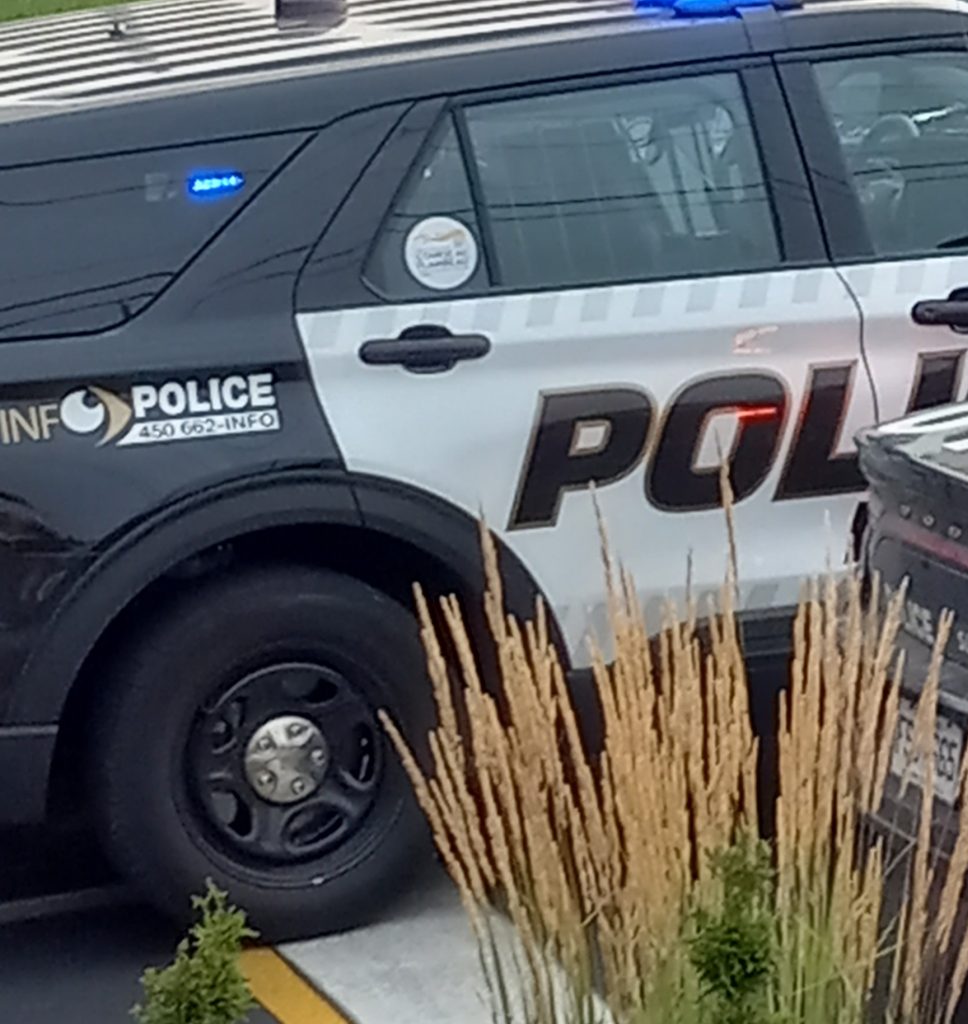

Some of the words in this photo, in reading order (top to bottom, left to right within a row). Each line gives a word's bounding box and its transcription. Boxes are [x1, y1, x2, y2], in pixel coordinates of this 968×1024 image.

[131, 373, 276, 418] POLICE
[138, 423, 175, 438] 450
[180, 413, 275, 436] 662-INFO
